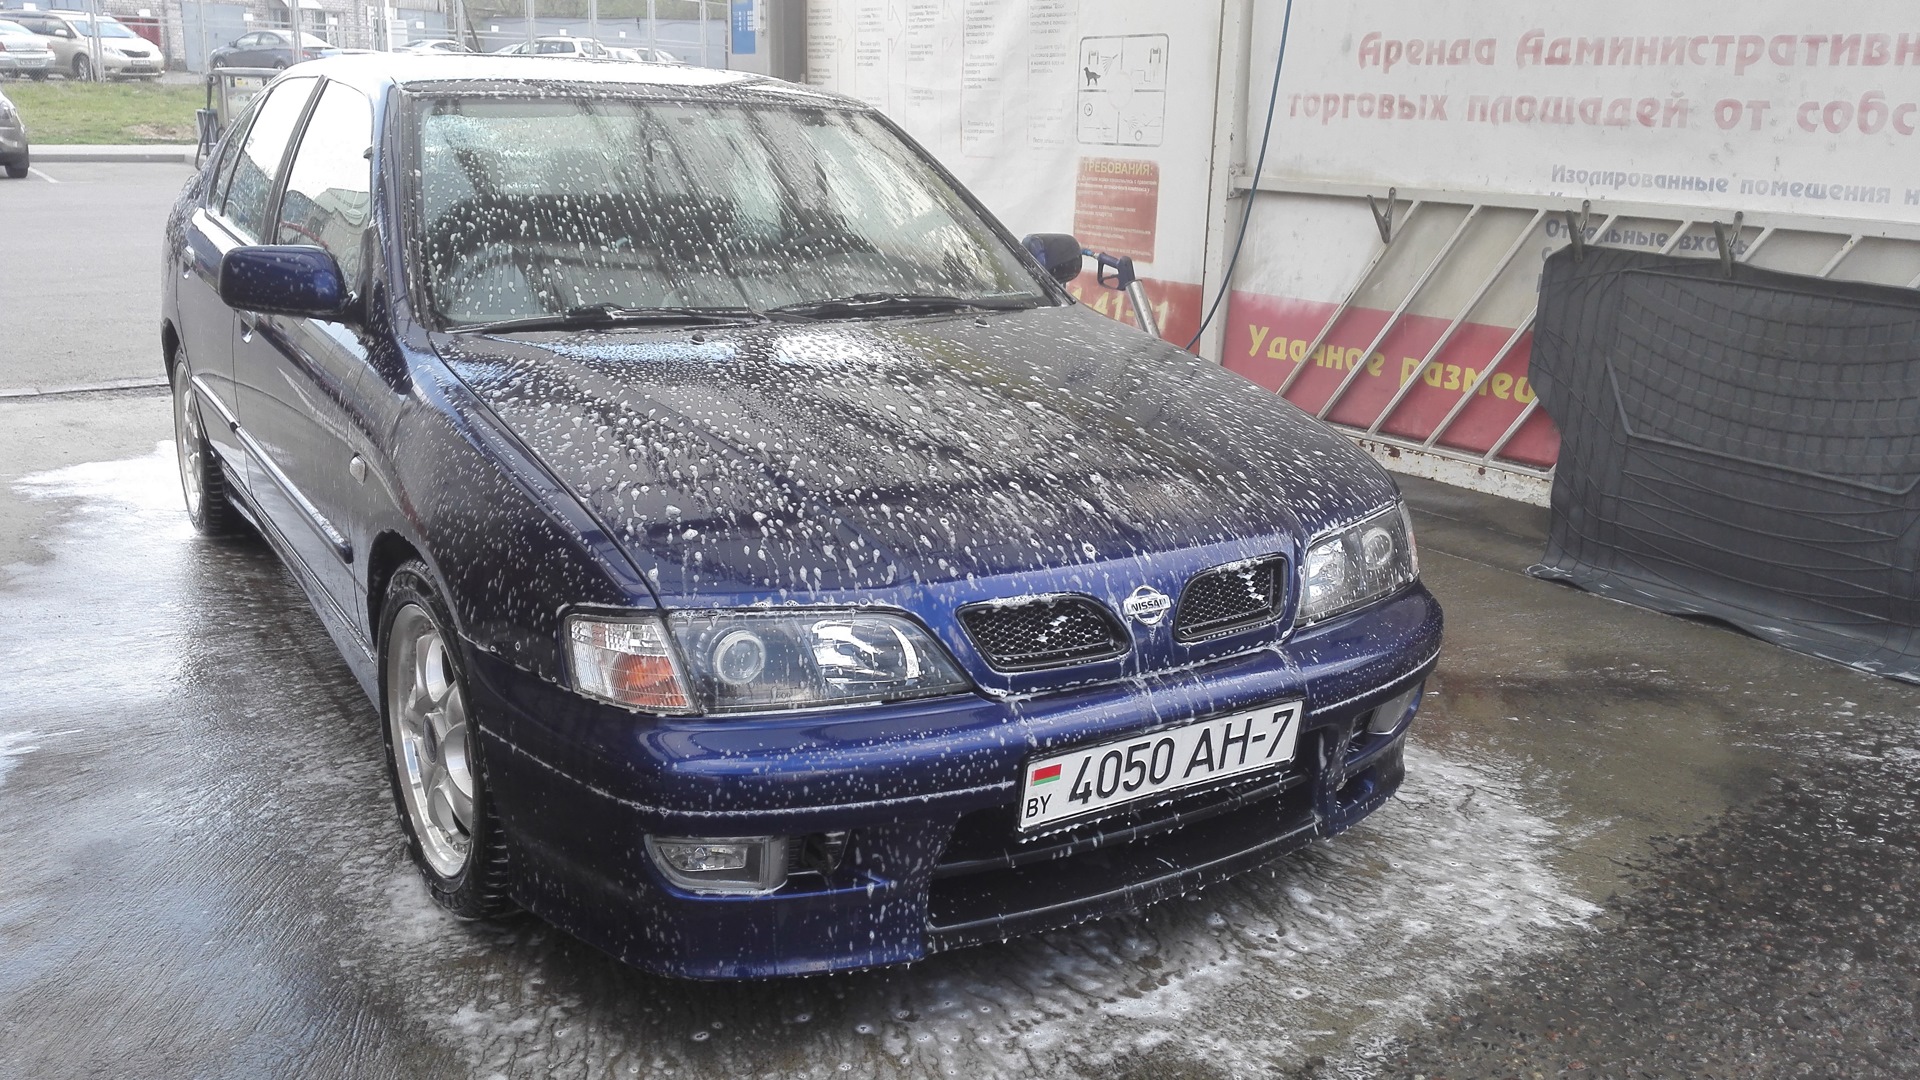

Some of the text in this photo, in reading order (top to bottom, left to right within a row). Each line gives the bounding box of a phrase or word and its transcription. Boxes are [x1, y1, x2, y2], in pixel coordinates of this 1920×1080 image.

[1358, 28, 1920, 76] Аренда Административн
[1288, 90, 1917, 136] торговых площадей от собс
[1083, 161, 1153, 176] ТРЕБОВАНИЯ:
[1551, 164, 1729, 193] Изолированные
[1740, 179, 1890, 204] помещения
[1248, 324, 1385, 377] Удачное
[1131, 598, 1167, 611] NISSAN
[1068, 708, 1295, 805] 4050 AH-7
[1025, 793, 1052, 819] BY
